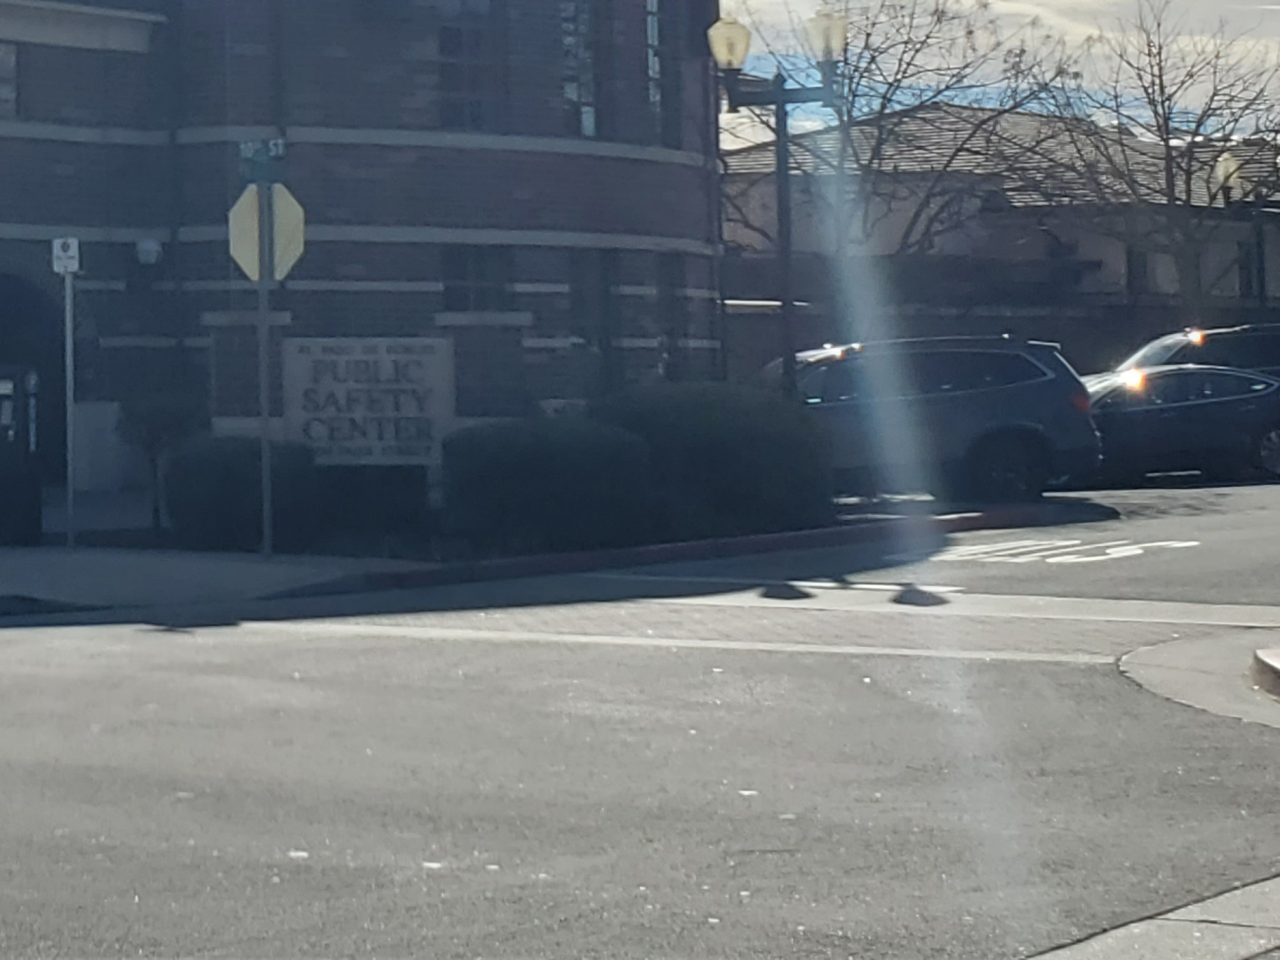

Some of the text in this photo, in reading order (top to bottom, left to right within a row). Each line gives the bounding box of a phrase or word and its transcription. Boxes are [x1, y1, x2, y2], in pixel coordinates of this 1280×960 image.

[311, 358, 423, 383] PUBLIC
[301, 387, 427, 413] SAFETY
[302, 416, 431, 441] CENTER
